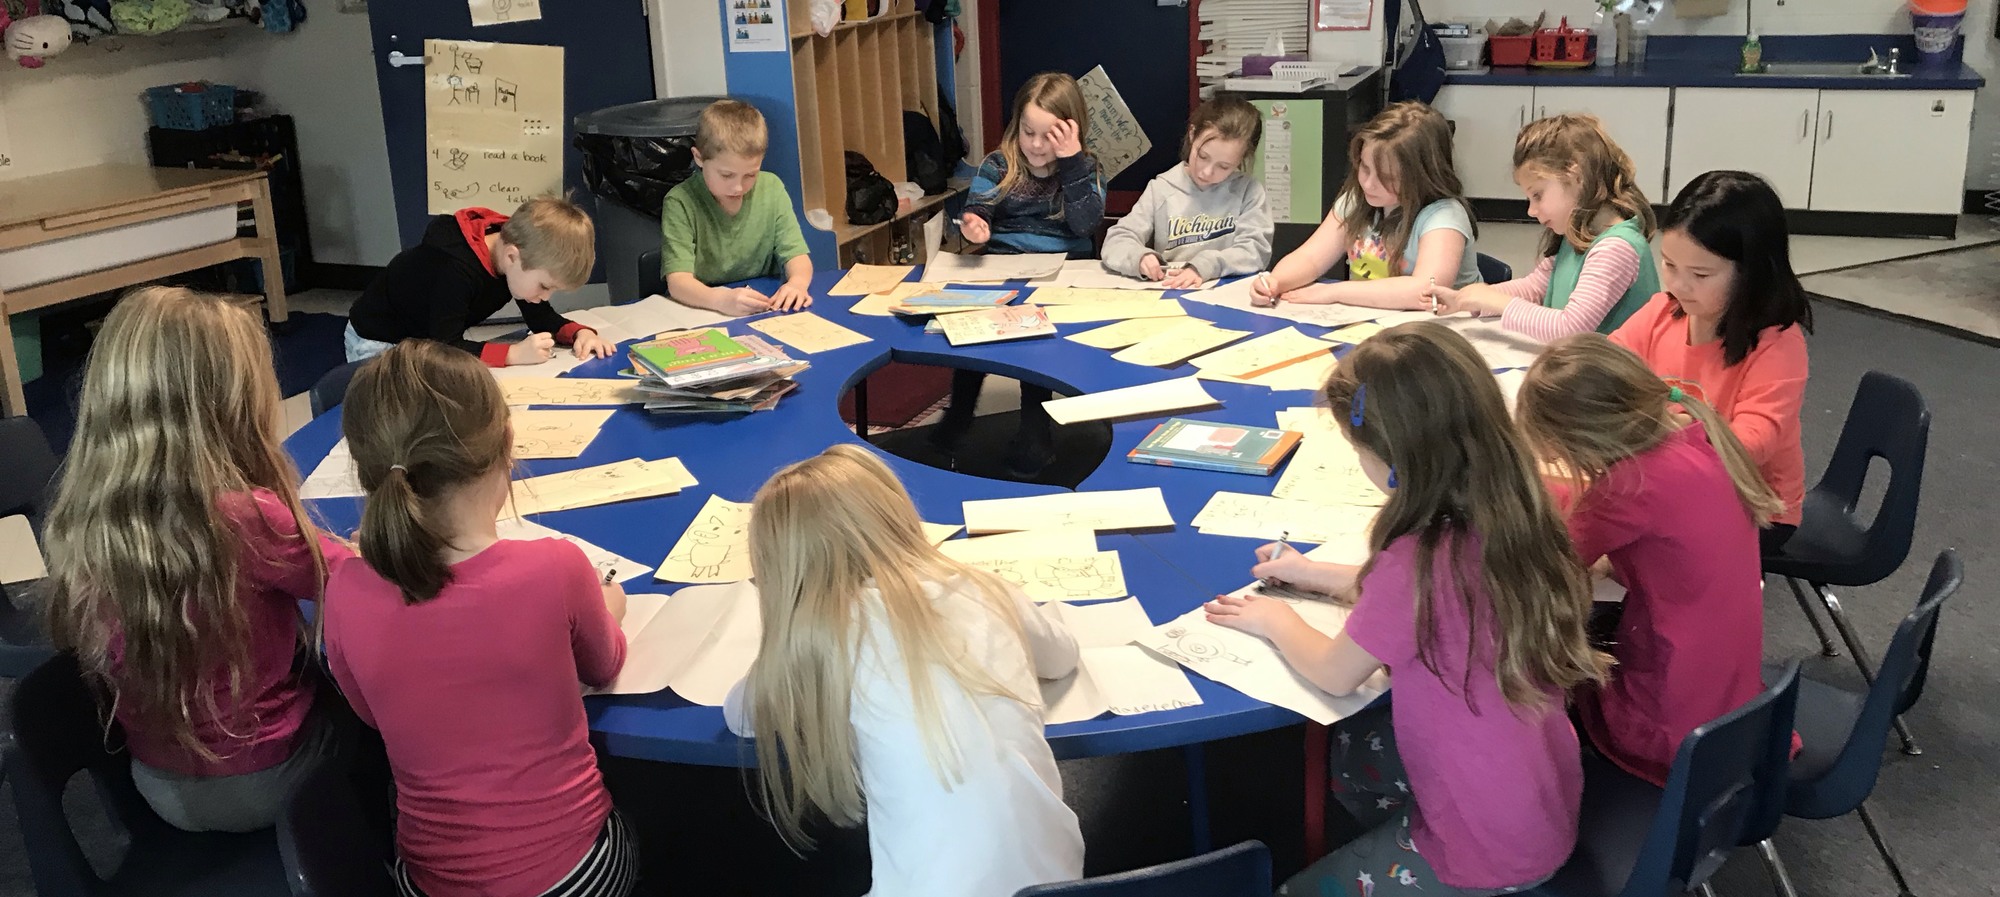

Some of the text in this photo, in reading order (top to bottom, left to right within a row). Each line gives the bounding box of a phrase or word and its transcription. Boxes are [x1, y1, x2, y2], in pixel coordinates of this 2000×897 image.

[1102, 92, 1118, 118] Team
[1110, 129, 1122, 143] the
[483, 150, 506, 160] read
[510, 152, 519, 160] a
[522, 150, 548, 163] book
[1167, 215, 1234, 239] Michigan
